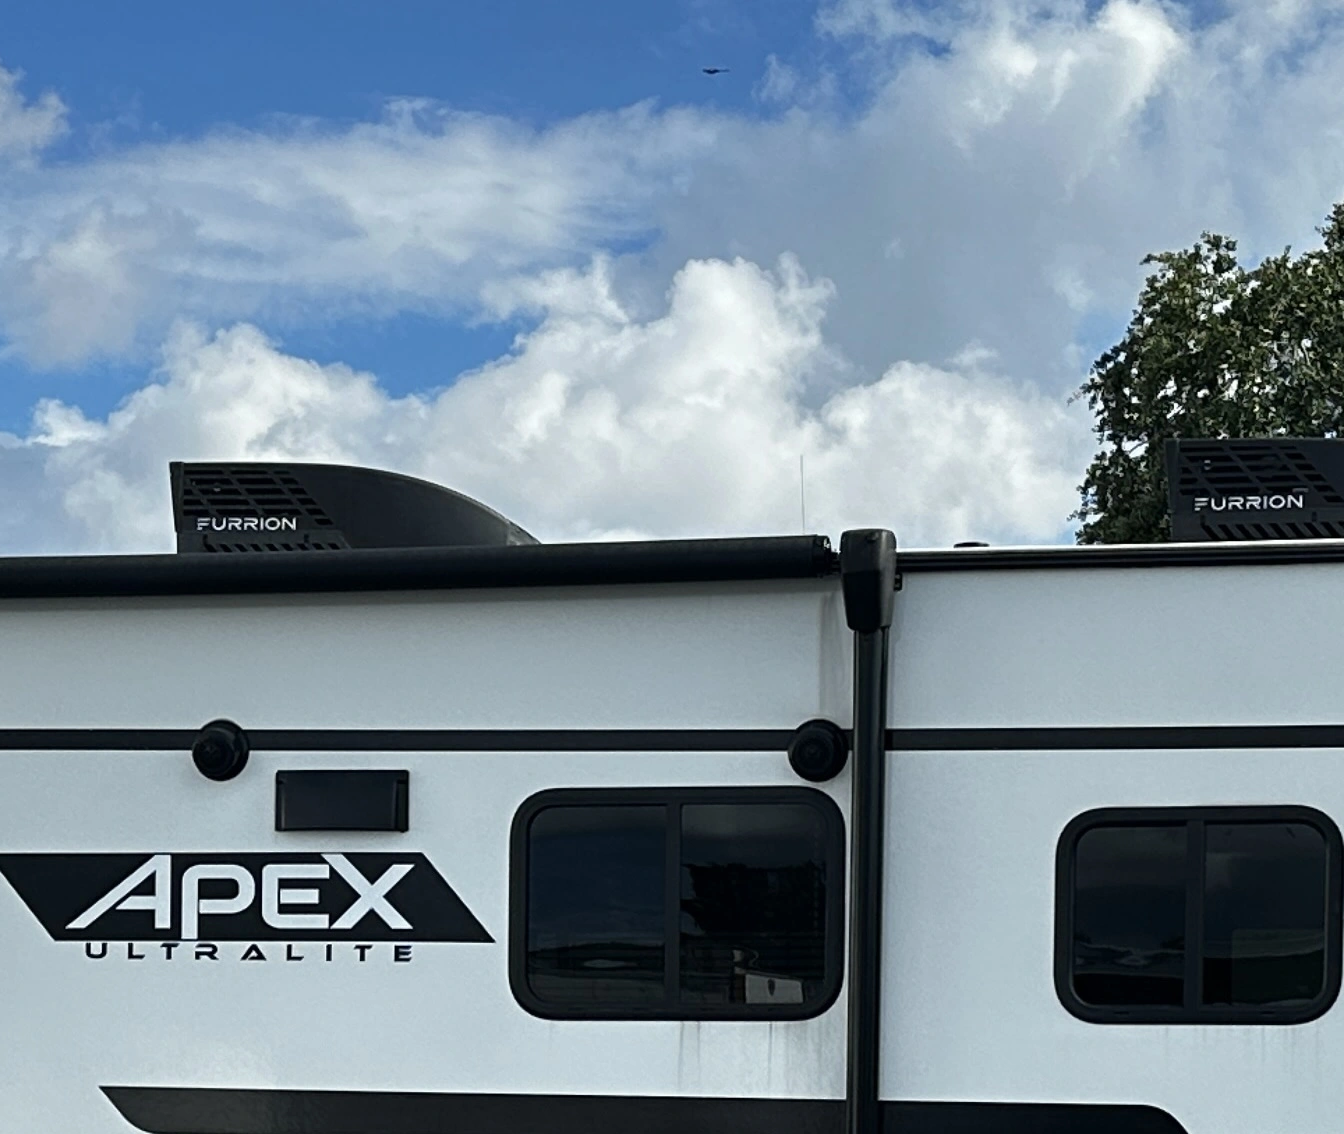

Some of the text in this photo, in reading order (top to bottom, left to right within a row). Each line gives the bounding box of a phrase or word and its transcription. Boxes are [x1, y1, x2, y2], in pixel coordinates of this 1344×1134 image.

[1194, 494, 1303, 512] FURRION
[196, 517, 297, 531] FURRION
[65, 853, 415, 940] APEX
[85, 942, 413, 962] ULTRALITE
